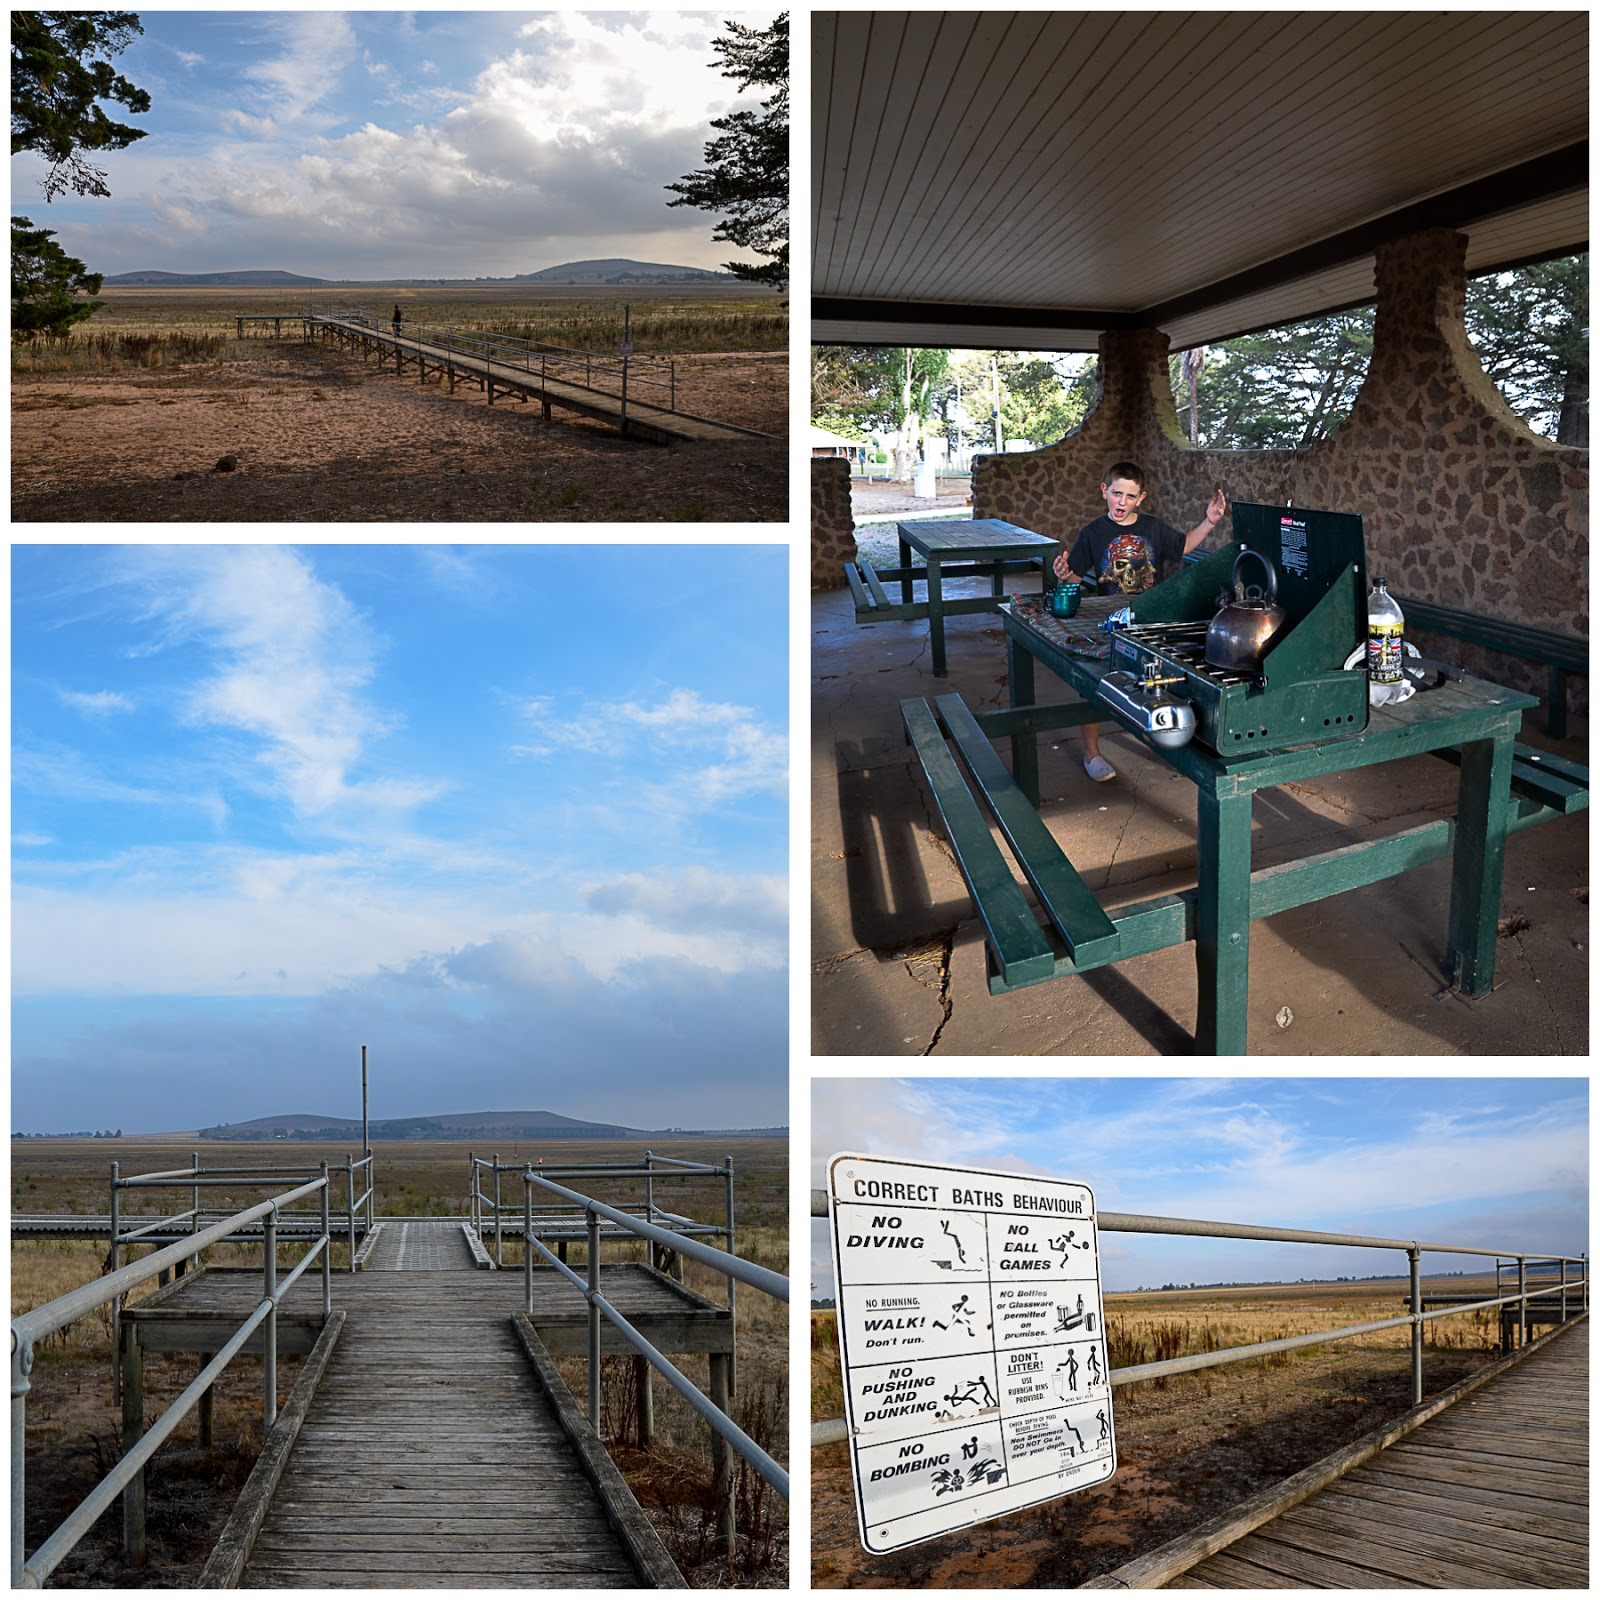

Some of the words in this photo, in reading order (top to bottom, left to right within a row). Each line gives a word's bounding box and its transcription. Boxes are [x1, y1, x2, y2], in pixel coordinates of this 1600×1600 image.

[854, 1179, 939, 1203] CORRECT
[952, 1188, 1004, 1208] BATHS
[1013, 1194, 1083, 1214] BEHAVIOUR
[871, 1216, 902, 1229] NO
[1007, 1225, 1029, 1236] NO
[846, 1235, 925, 1249] DIVING
[1000, 1259, 1052, 1270] GAMES
[865, 1299, 878, 1308] NO
[881, 1297, 921, 1307] RUNNING.
[1008, 1300, 1054, 1309] Glassware
[1003, 1311, 1047, 1321] permitted
[864, 1316, 926, 1332] WALK!
[865, 1337, 898, 1348] Don't
[902, 1336, 925, 1345] run.
[1010, 1352, 1039, 1363] DON'T
[1007, 1360, 1044, 1373] LITTER!
[888, 1367, 913, 1379] NO
[862, 1376, 936, 1396] PUSHING
[1021, 1376, 1033, 1385] USE
[1008, 1386, 1033, 1396] RUBBISH
[1035, 1383, 1049, 1392] BINS
[882, 1391, 917, 1406] AND
[863, 1401, 938, 1423] DUNKING
[1027, 1429, 1064, 1441] Swimmers
[898, 1443, 924, 1458] NO
[1013, 1443, 1025, 1451] DO
[1025, 1439, 1042, 1448] NOT
[1011, 1451, 1027, 1459] over
[1029, 1447, 1045, 1456] your
[870, 1453, 951, 1482] BOMBING
